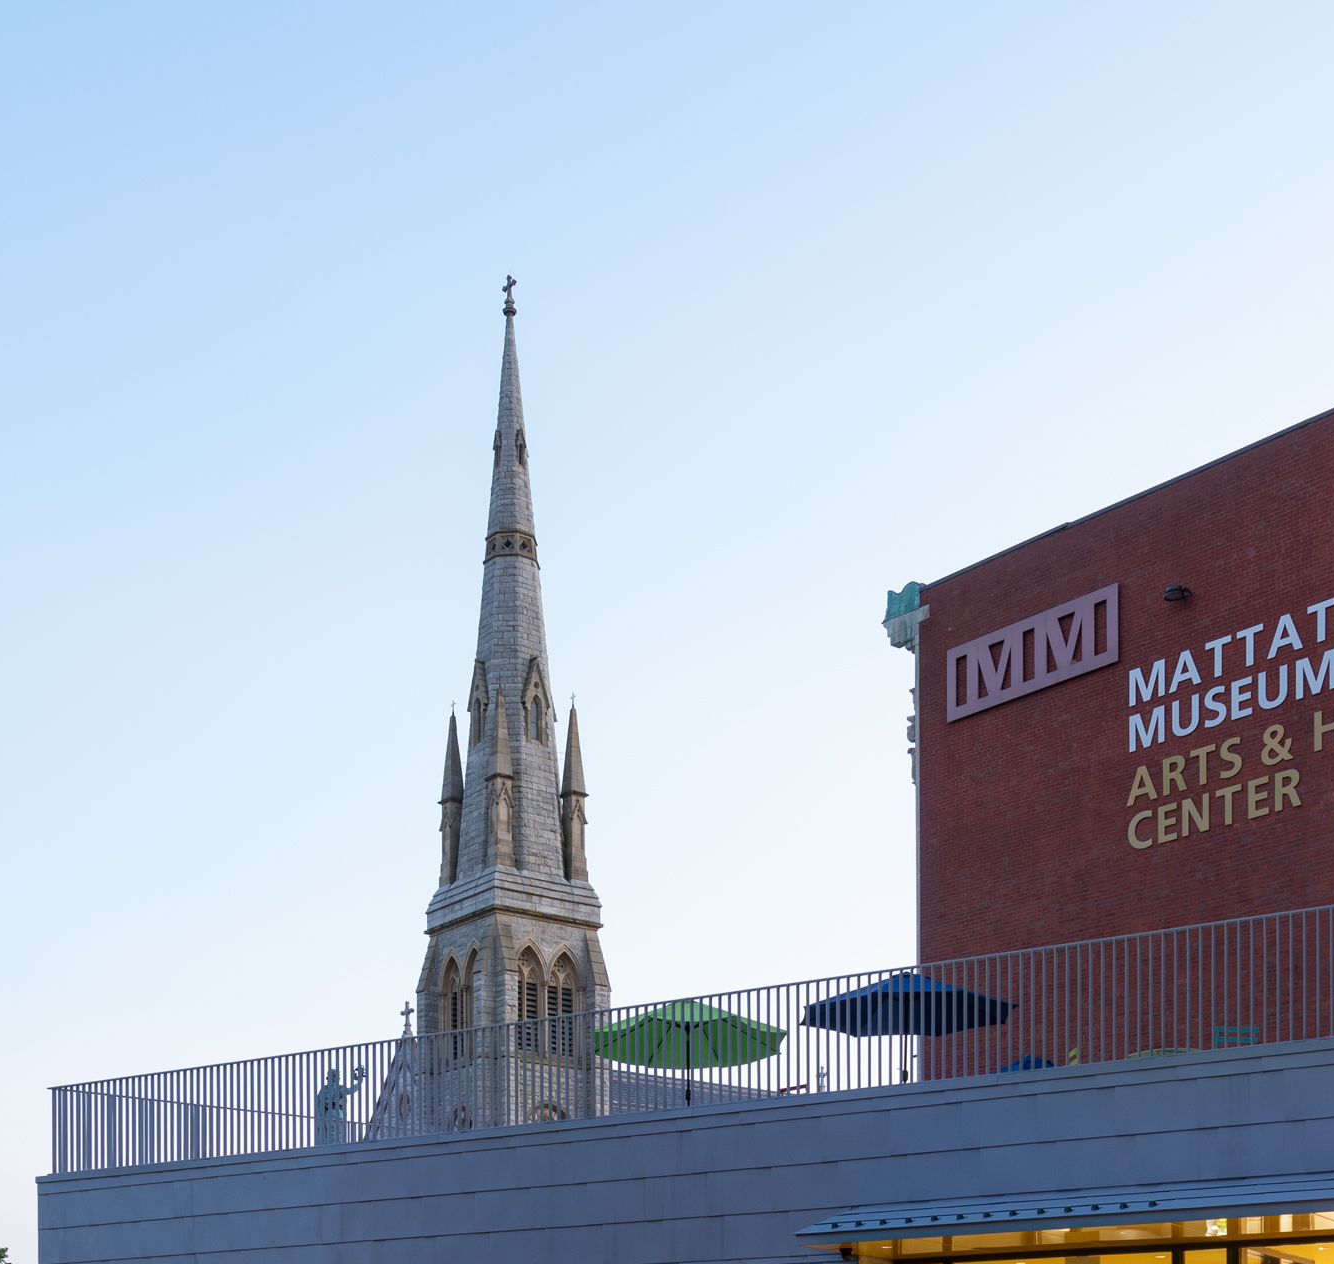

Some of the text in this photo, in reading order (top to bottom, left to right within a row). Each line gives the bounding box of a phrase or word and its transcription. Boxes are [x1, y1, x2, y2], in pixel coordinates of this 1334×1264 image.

[1126, 736, 1243, 808] ARTS
[1260, 723, 1294, 766] &
[1126, 768, 1302, 850] CENTER
